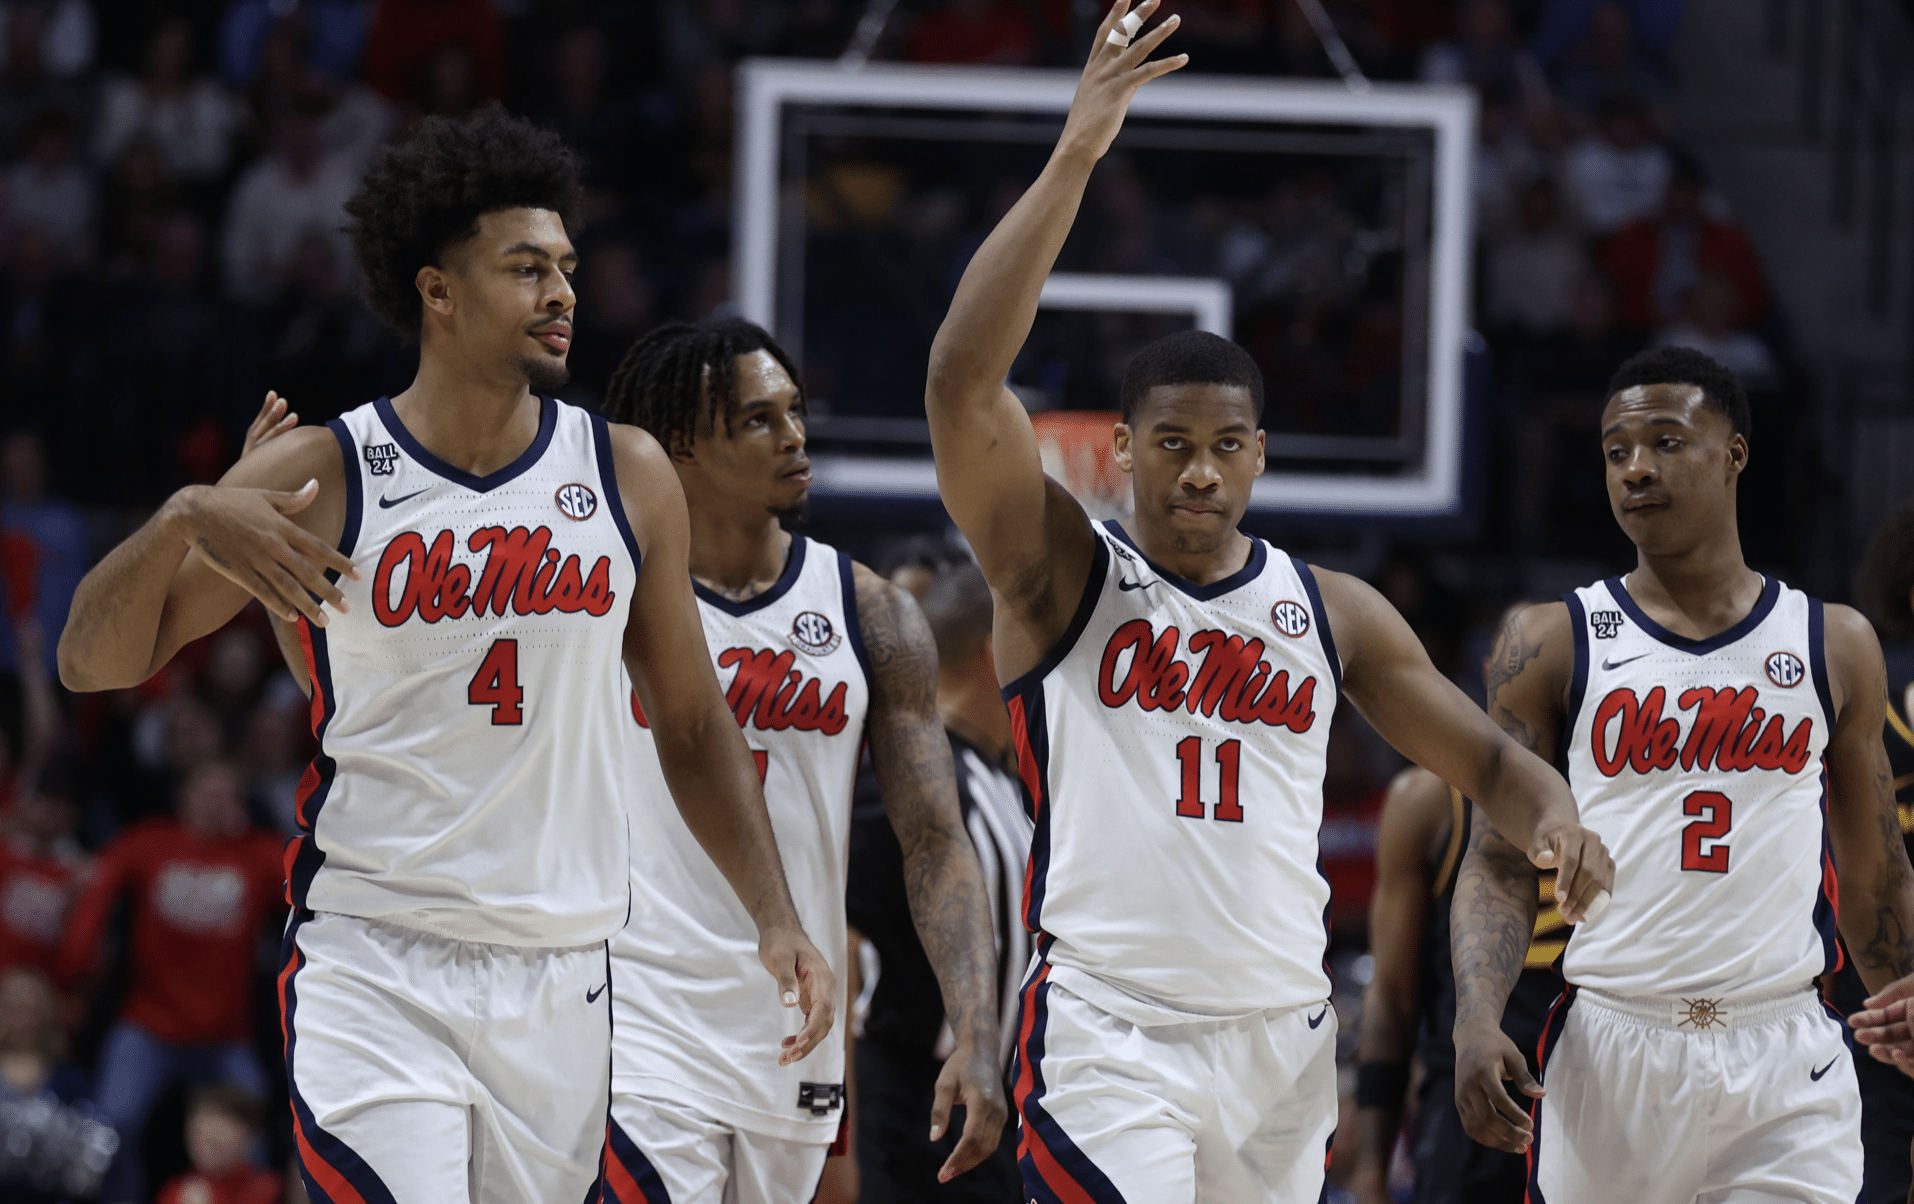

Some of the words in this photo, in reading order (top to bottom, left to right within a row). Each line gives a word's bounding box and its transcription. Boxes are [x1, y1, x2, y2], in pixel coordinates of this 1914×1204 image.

[366, 444, 397, 460] BALL
[372, 459, 392, 473] 24
[561, 486, 594, 518] SEC
[372, 529, 472, 628] Ole
[468, 525, 616, 617] Miss
[796, 613, 830, 645] SEC
[1274, 603, 1307, 635] SEC
[1593, 612, 1622, 625] BALL
[1597, 623, 1616, 637] 24
[467, 638, 524, 726] 4
[1098, 618, 1189, 713] Ole
[1185, 628, 1317, 734] Miss
[1767, 653, 1801, 686] SEC
[718, 646, 849, 736] Miss
[1591, 685, 1680, 778] Ole
[1678, 685, 1813, 775] Miss
[1175, 735, 1244, 823] 11
[1680, 790, 1733, 874] 2
